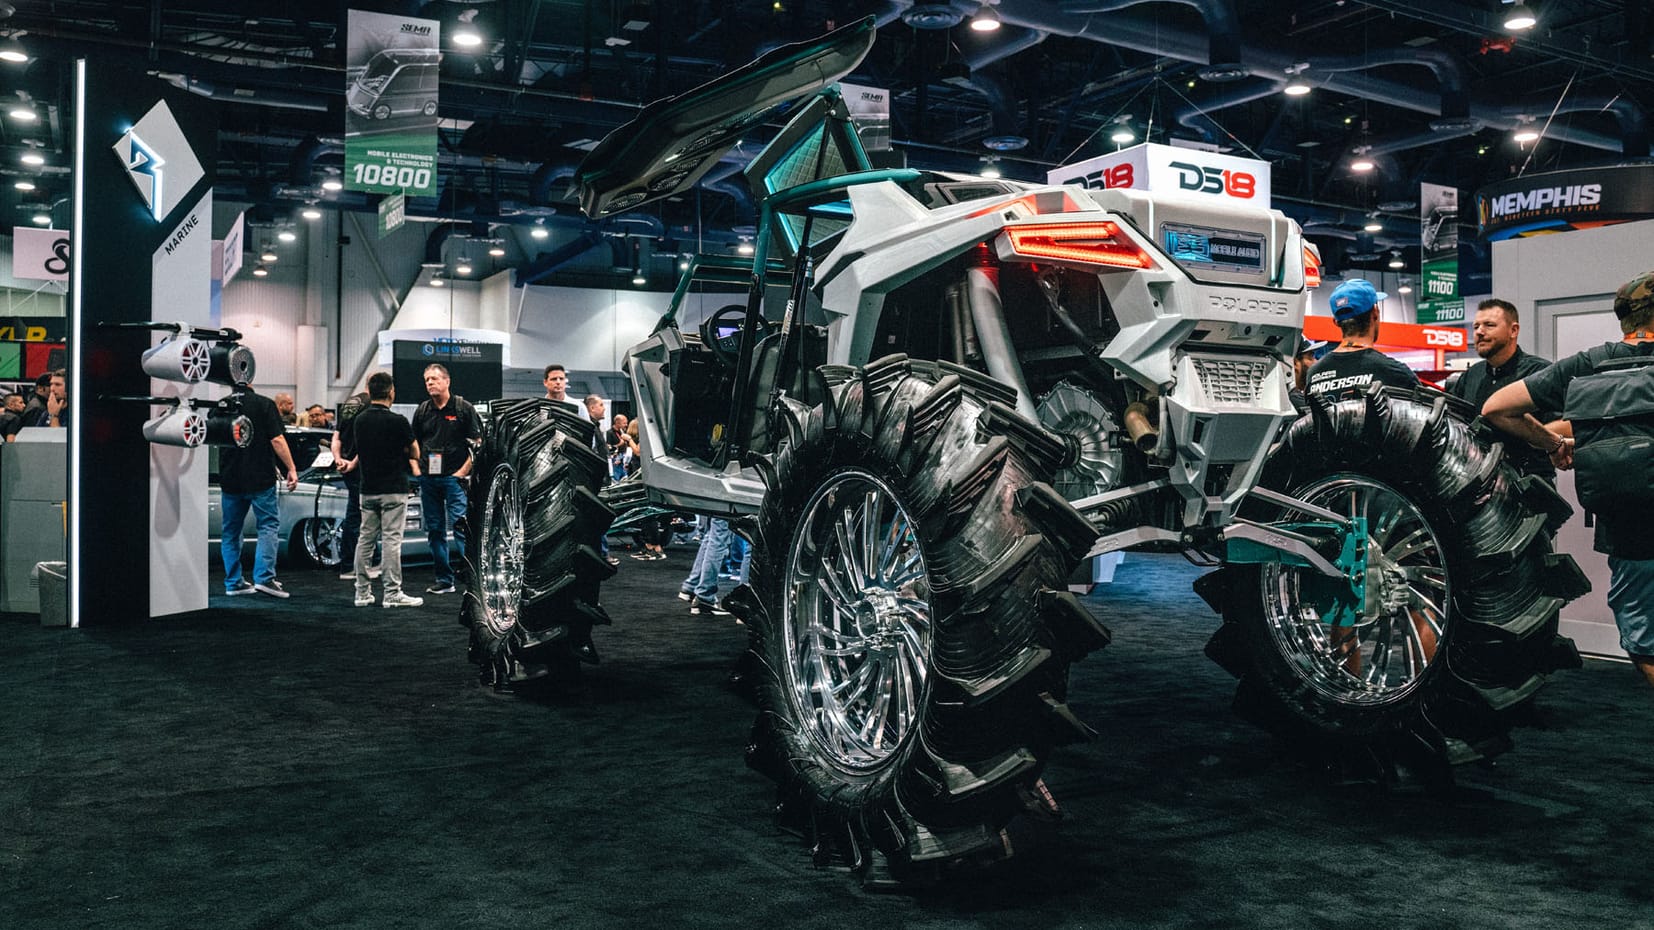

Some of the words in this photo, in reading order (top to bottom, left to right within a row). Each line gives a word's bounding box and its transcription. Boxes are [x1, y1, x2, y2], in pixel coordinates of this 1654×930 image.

[391, 152, 434, 161] ELECTRONICS
[393, 158, 433, 168] TECHNOLOGY
[354, 163, 431, 189] 10800
[1168, 161, 1256, 199] DS18
[1491, 183, 1602, 218] MEMPHIS
[165, 214, 199, 255] MARINE
[1428, 279, 1454, 295] 11100
[1436, 307, 1464, 321] 11100
[1422, 328, 1463, 347] DS18
[1307, 373, 1373, 395] ANDERSON
